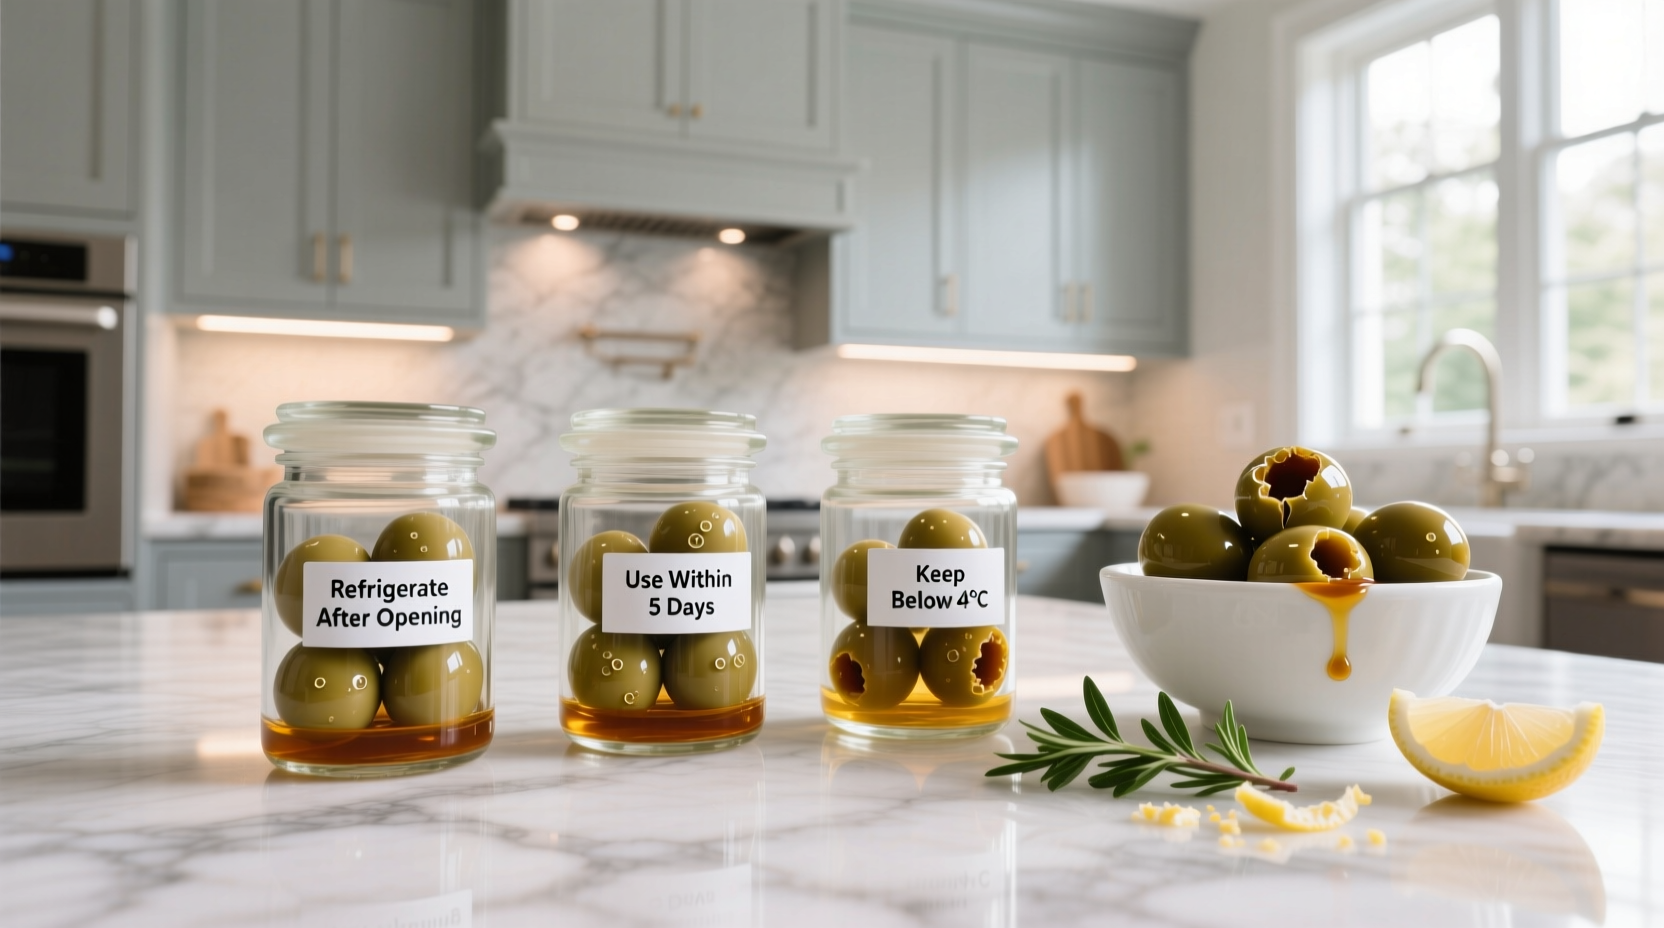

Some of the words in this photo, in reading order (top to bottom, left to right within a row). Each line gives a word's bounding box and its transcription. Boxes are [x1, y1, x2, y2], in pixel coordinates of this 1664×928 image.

[625, 569, 664, 590] Use
[668, 568, 732, 589] Within
[916, 564, 965, 588] Keep
[331, 578, 449, 604] Refrigerate
[891, 589, 953, 610] Below
[315, 606, 371, 628] After
[376, 605, 462, 632] Opening
[648, 597, 661, 617] 5
[667, 597, 715, 621] Days
